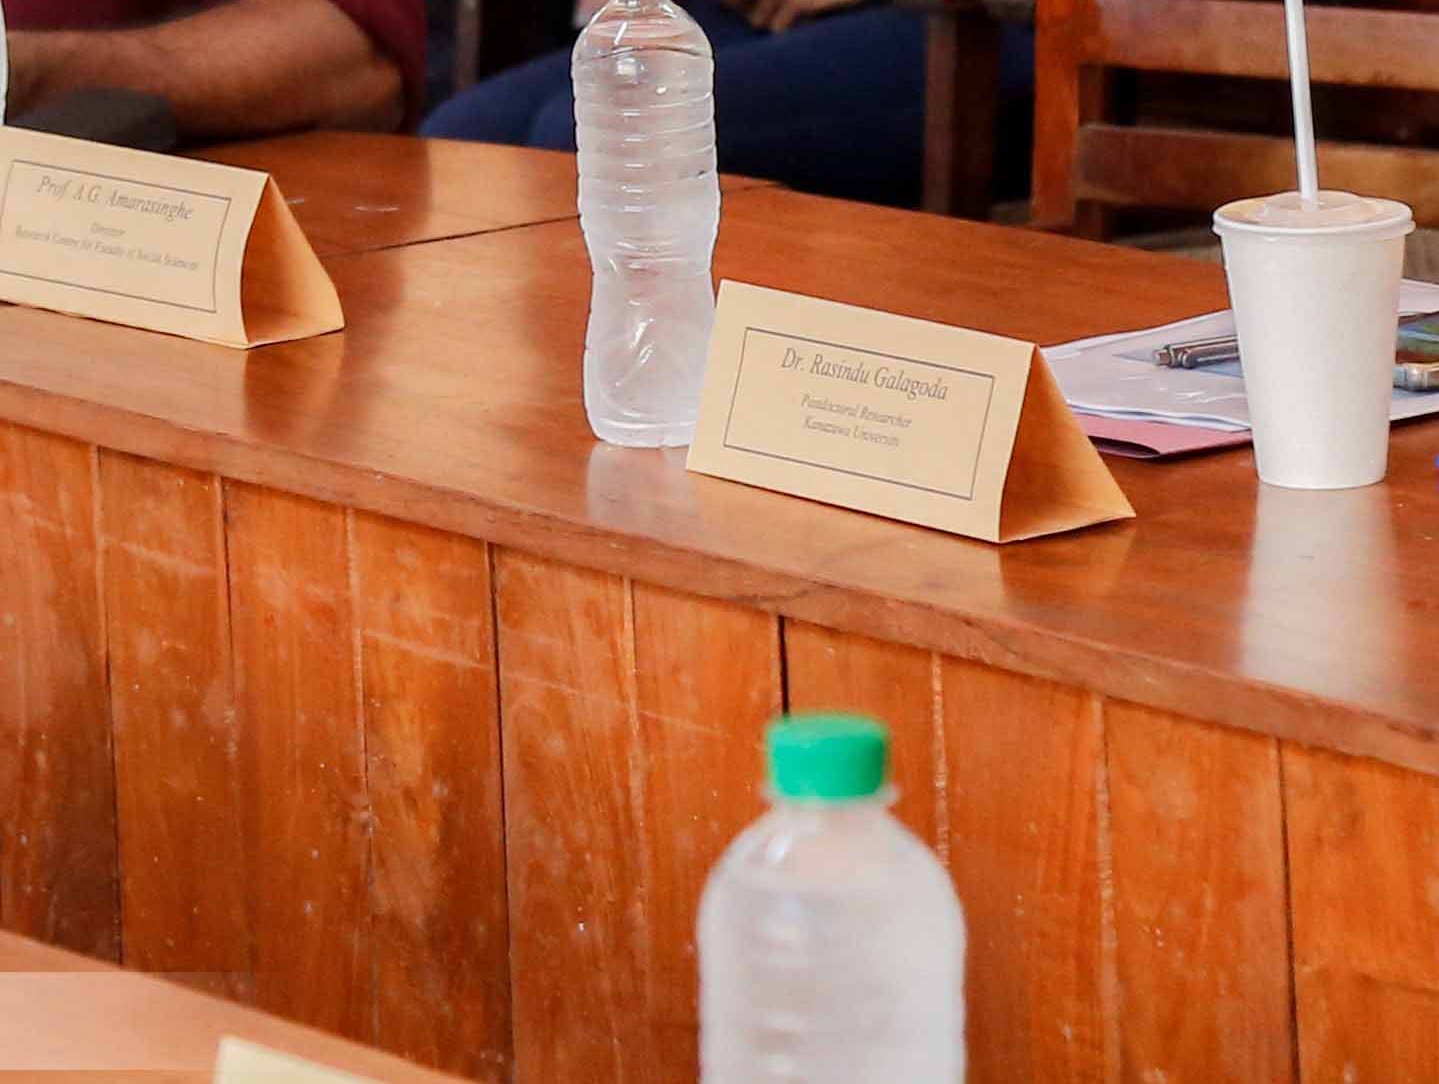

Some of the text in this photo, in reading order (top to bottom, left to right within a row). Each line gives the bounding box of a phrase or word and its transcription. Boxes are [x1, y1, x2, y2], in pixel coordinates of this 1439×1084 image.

[780, 347, 949, 401] Dr. Rasindu Galagoda
